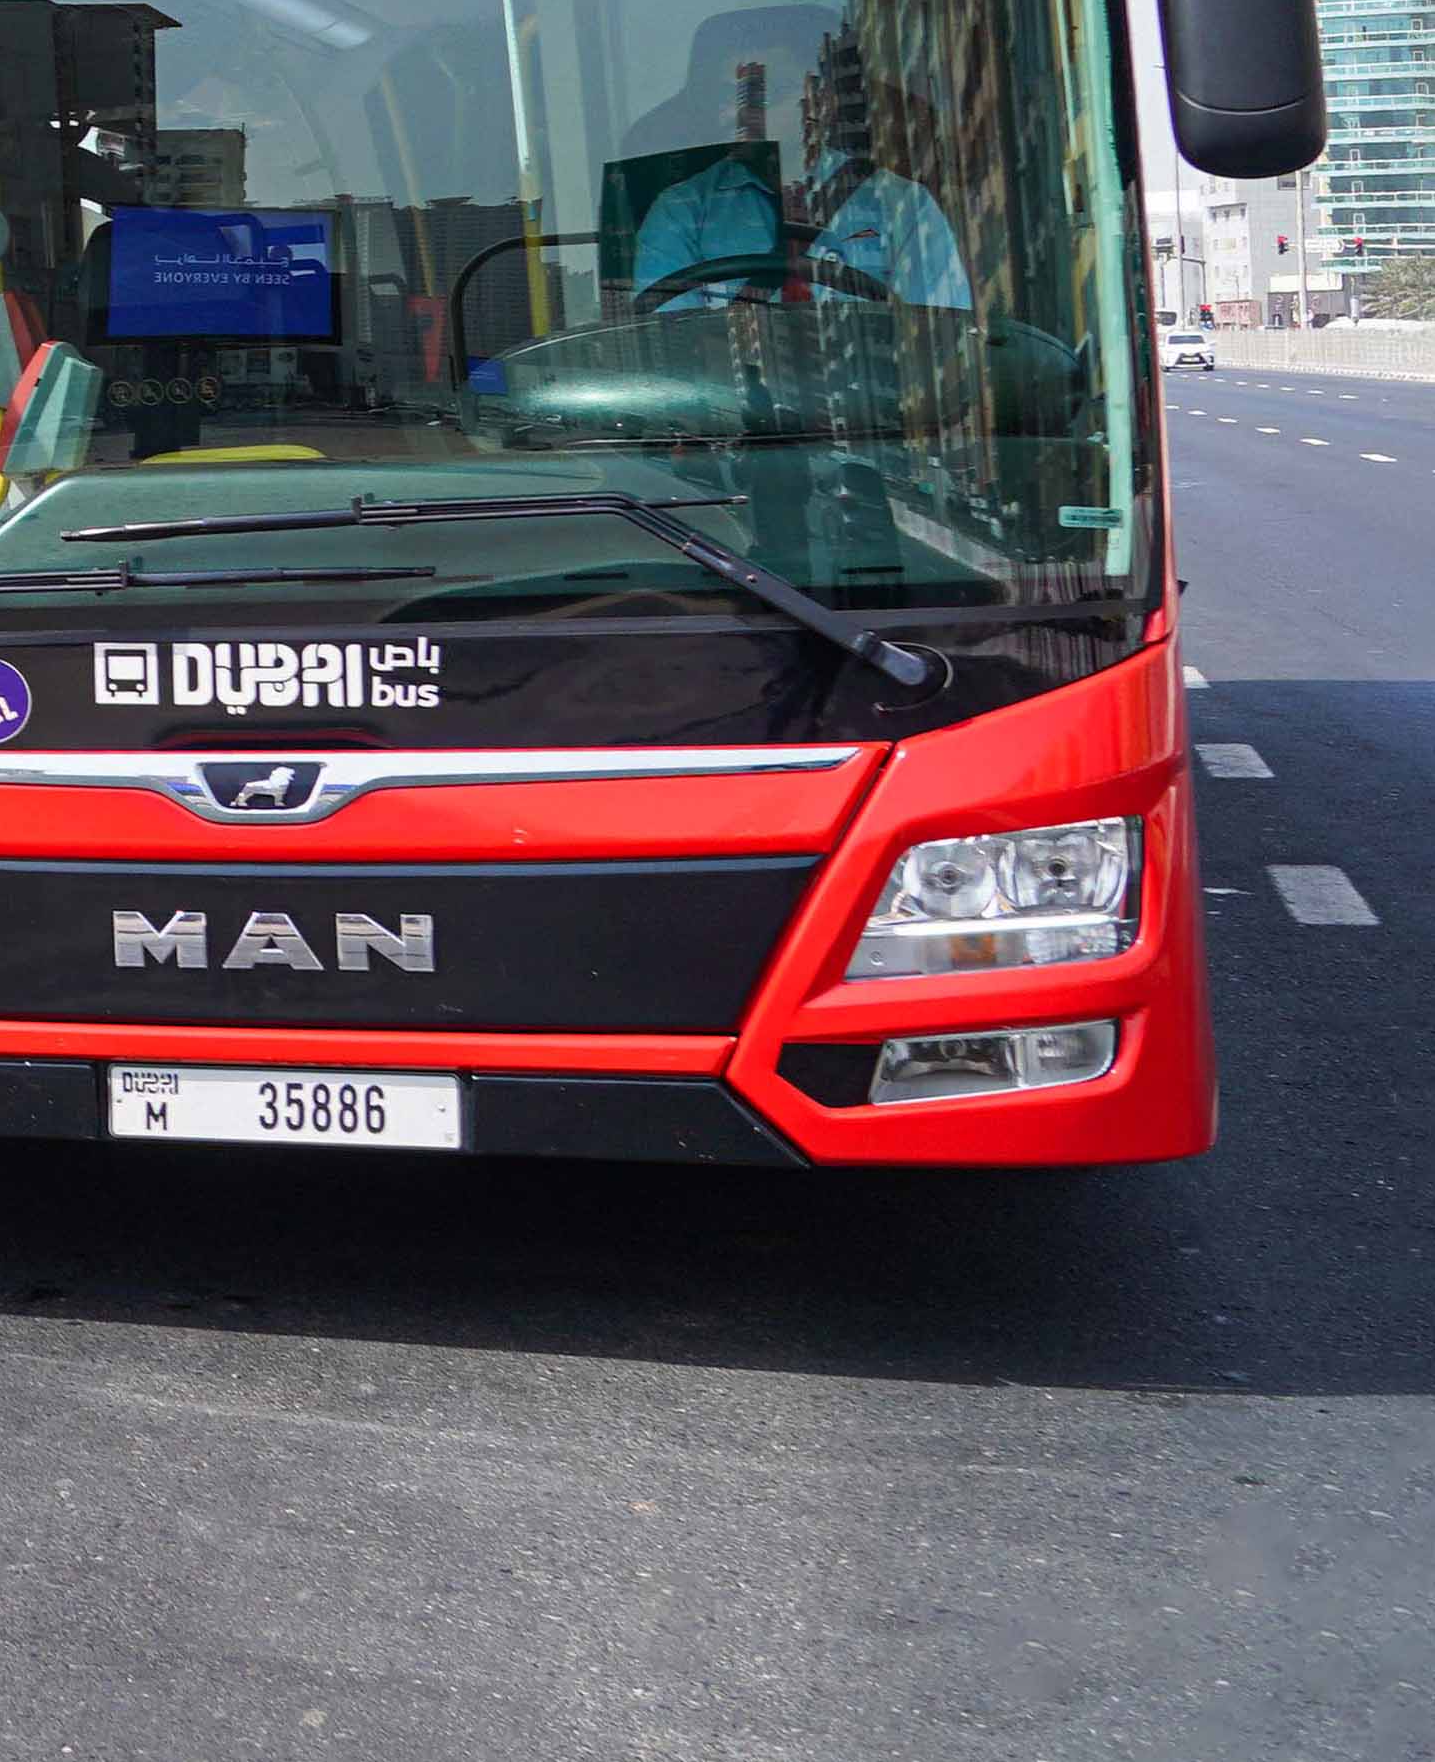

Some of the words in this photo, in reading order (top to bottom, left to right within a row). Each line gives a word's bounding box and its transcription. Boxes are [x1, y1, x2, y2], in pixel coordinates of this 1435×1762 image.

[172, 642, 364, 713] DUBAI
[370, 676, 441, 708] bus
[368, 636, 441, 675] باص
[112, 909, 437, 974] MAN
[145, 1101, 169, 1131] M
[258, 1082, 387, 1134] 35886
